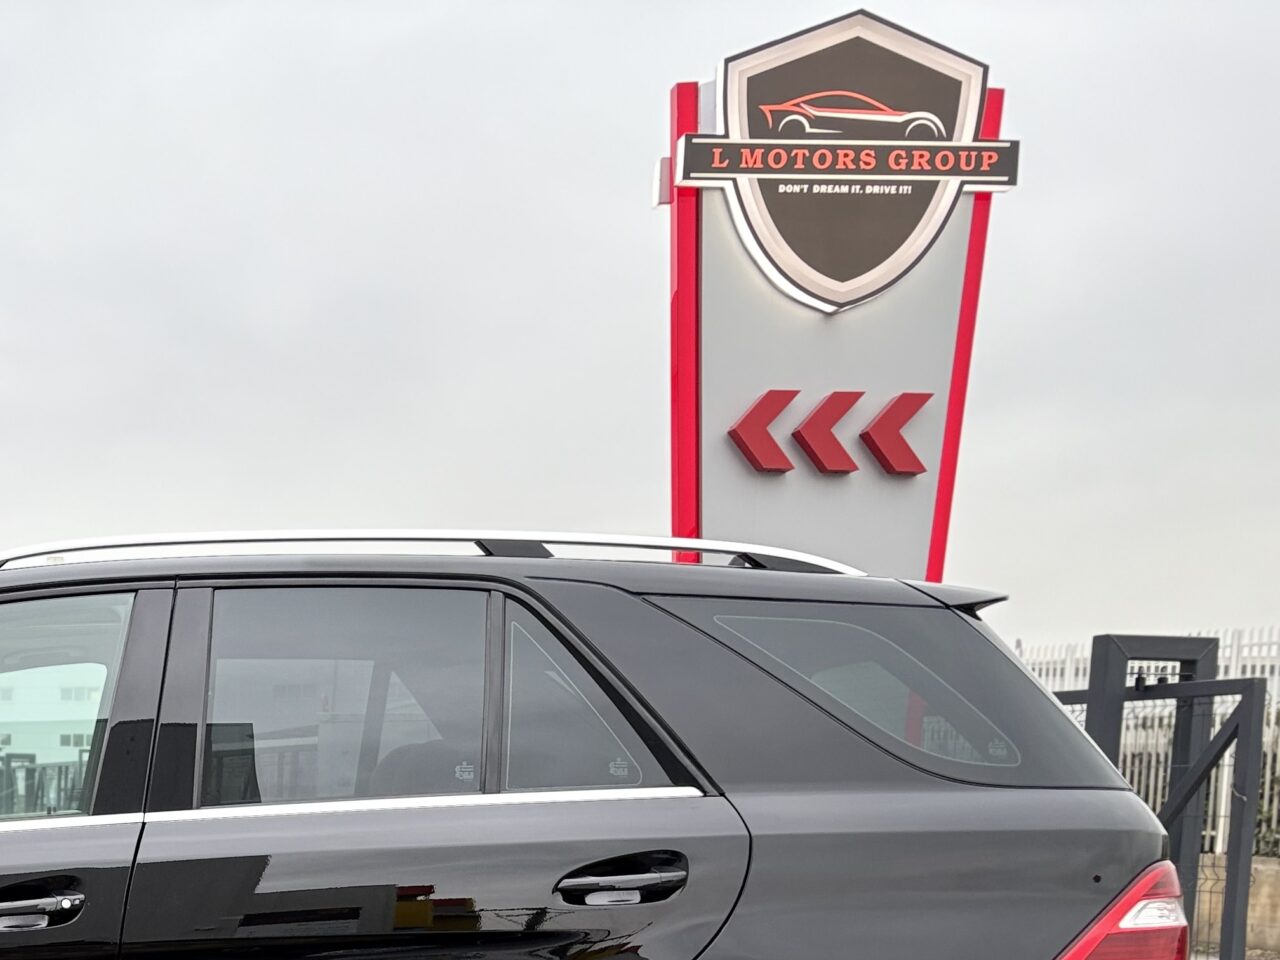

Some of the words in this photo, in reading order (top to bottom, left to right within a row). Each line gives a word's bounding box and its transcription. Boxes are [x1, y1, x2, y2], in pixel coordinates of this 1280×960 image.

[711, 148, 729, 168] L
[739, 148, 877, 170] MOTORS
[887, 150, 999, 171] GROUP
[778, 184, 809, 194] DON'T
[812, 184, 849, 194] DREAM
[865, 185, 897, 194] DRIVE
[898, 185, 912, 195] IT!
